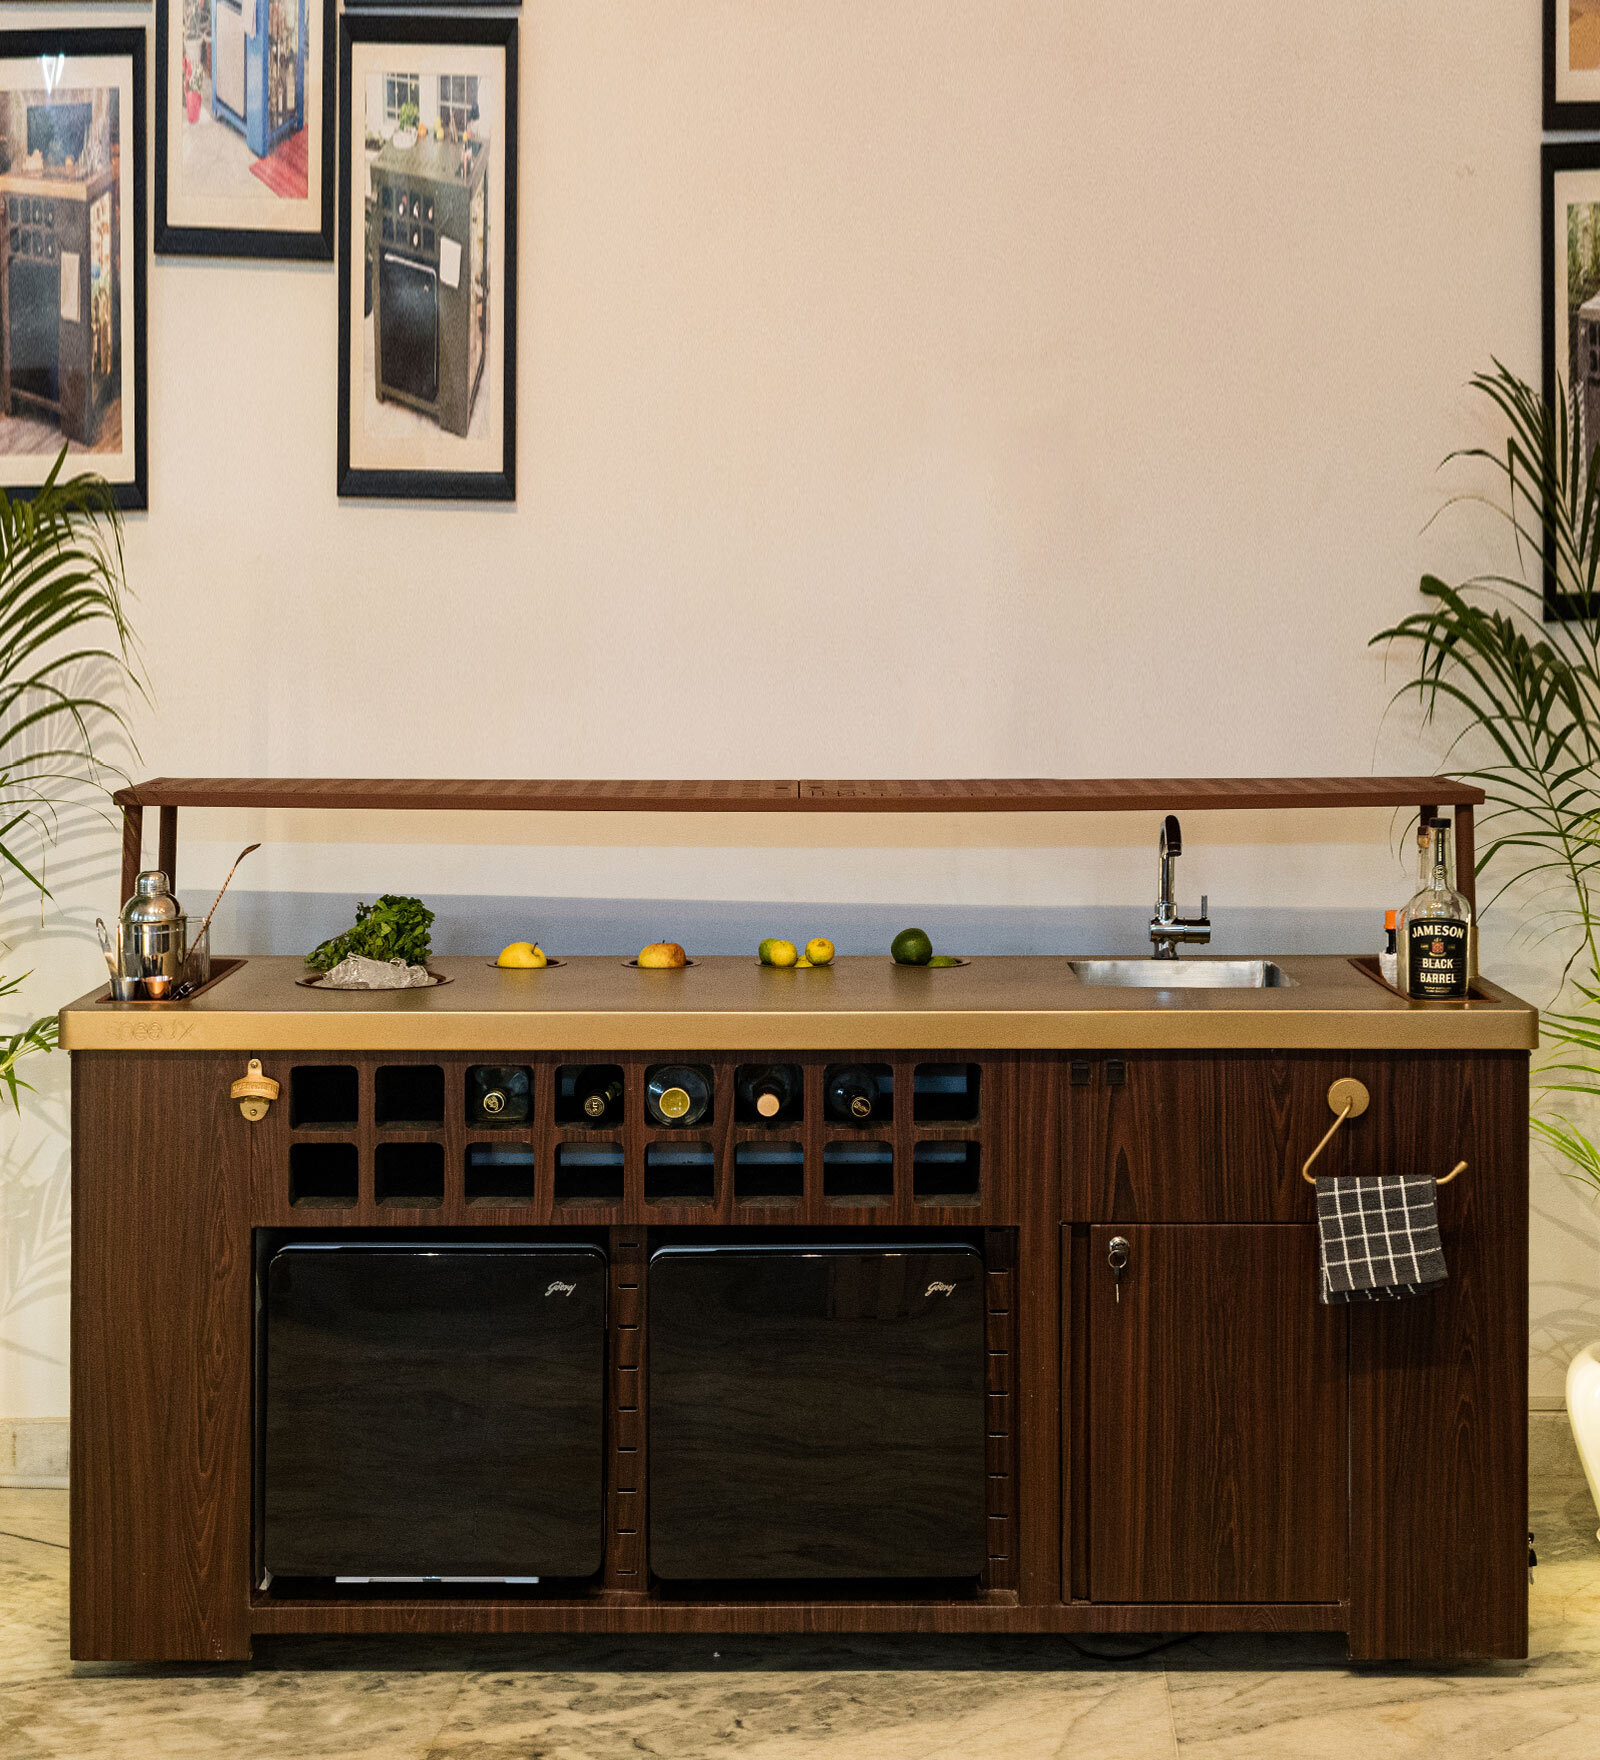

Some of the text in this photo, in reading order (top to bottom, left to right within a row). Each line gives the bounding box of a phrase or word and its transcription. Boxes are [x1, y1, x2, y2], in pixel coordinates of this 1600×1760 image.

[1412, 925, 1464, 939] JAMESON
[1422, 957, 1454, 969] BLACK
[1419, 972, 1457, 984] BARREL
